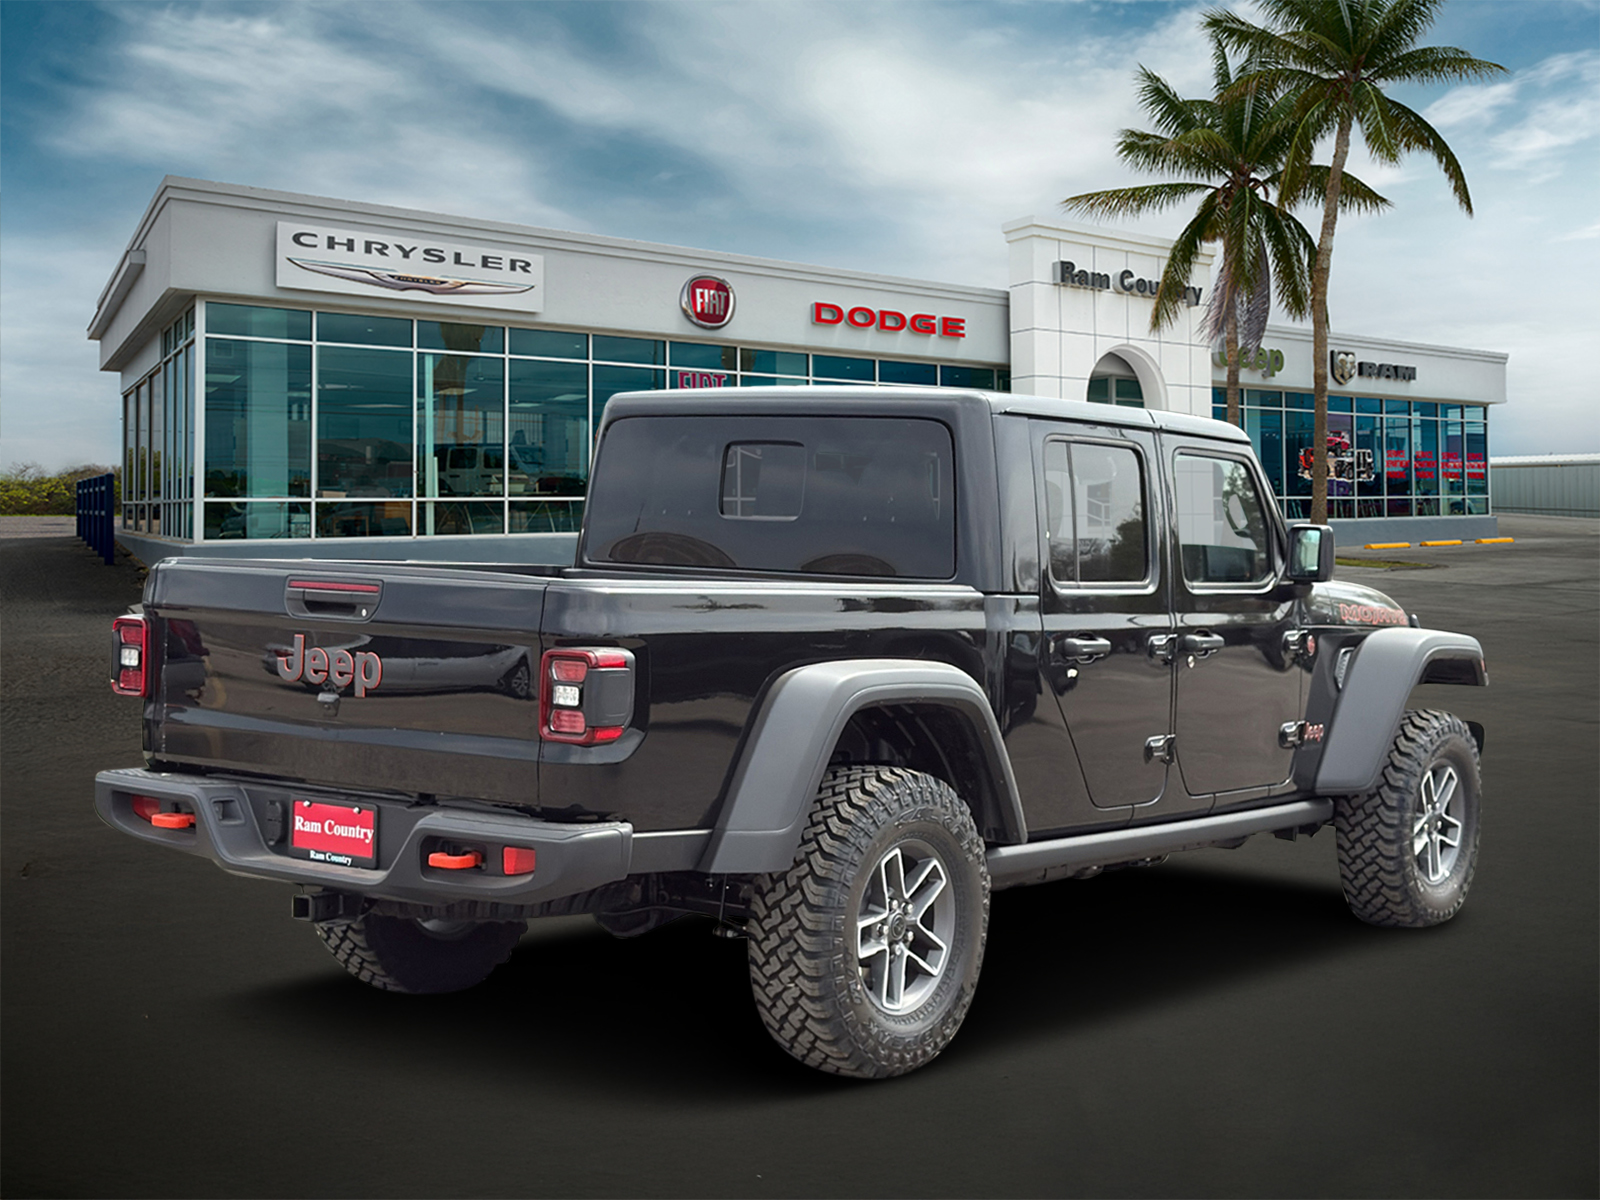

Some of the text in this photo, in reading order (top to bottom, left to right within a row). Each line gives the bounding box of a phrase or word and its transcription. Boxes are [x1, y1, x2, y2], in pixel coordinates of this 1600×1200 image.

[292, 232, 532, 274] CHRYSLER
[1053, 260, 1203, 307] Ram Coury
[695, 288, 728, 316] FIAT
[812, 301, 966, 339] DODGE
[1358, 361, 1416, 380] RAM
[277, 634, 382, 698] Jeep
[294, 815, 374, 844] Ram Country
[309, 849, 352, 866] Ram Country
